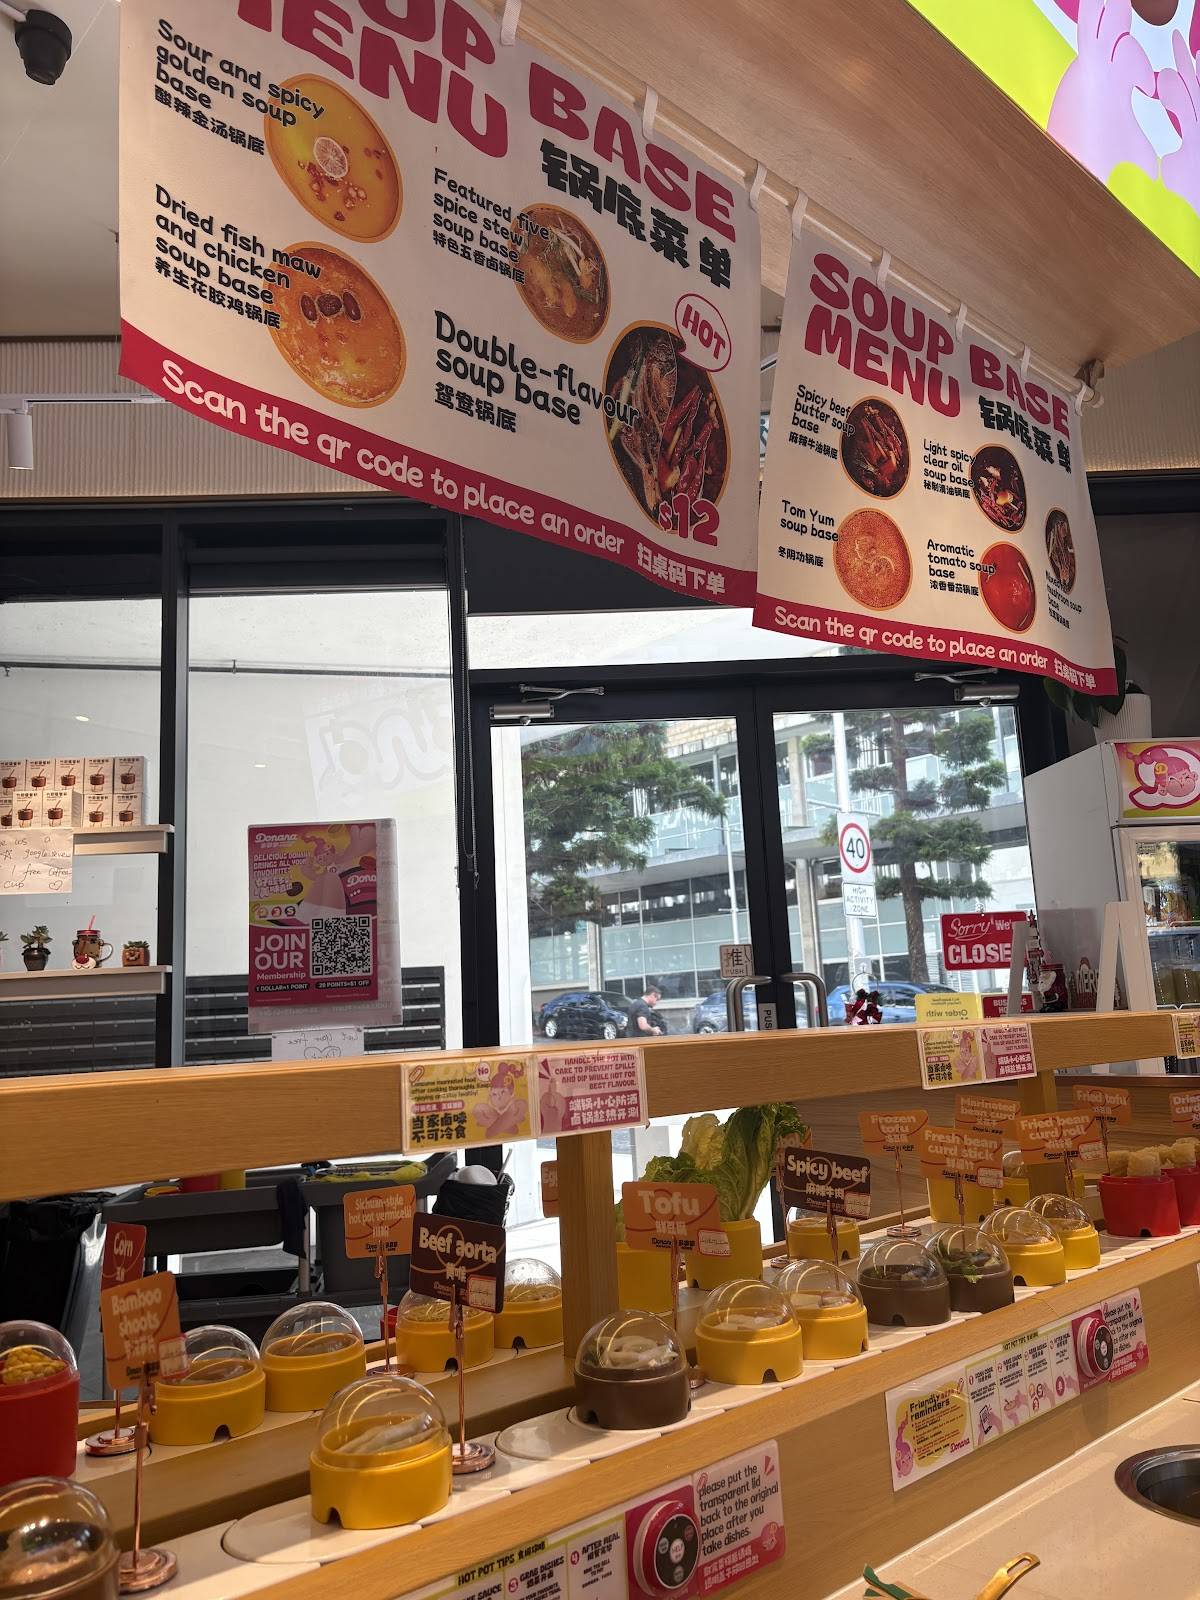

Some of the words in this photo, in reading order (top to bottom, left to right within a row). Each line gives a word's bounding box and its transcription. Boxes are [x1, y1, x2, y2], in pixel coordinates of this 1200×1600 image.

[158, 18, 212, 64] Sour
[219, 58, 261, 90] and
[268, 80, 325, 120] spicy
[156, 62, 212, 109] base
[156, 45, 235, 99] golden
[242, 90, 297, 127] soup
[154, 84, 265, 156] 酸辣金汤锅底
[529, 62, 736, 243] BASE
[434, 168, 512, 223] Featured
[517, 213, 551, 240] five
[540, 138, 731, 289] 锅底菜单
[155, 183, 214, 236] Dried
[221, 215, 265, 258] fish
[272, 246, 321, 279] maw
[434, 193, 478, 224] spice
[483, 215, 524, 247] stew
[155, 213, 196, 249] and
[203, 238, 290, 289] chicken
[433, 213, 474, 242] soup
[479, 230, 519, 263] base
[155, 236, 210, 279] soup
[218, 266, 274, 305] base
[432, 230, 525, 285] 特色五香卤锅底
[155, 256, 281, 329] 养生花胶鸡锅底
[682, 304, 726, 360] HOT
[809, 252, 954, 366] SOUP
[969, 343, 1070, 441] BASE
[434, 310, 640, 428] Double-flavour
[804, 303, 961, 418] MENU
[436, 349, 505, 397] soup
[515, 372, 581, 425] base
[796, 384, 827, 409] Spicy
[830, 398, 851, 417] beef
[435, 381, 516, 433] 鸳鸯锅底
[794, 398, 830, 423] butter
[832, 417, 855, 436] soup
[791, 412, 819, 434] base
[161, 359, 247, 424] Scan
[255, 403, 309, 446] the
[317, 432, 351, 463] qr
[357, 448, 424, 488] code
[431, 467, 459, 500] to
[463, 483, 535, 525] place
[541, 512, 570, 538] an
[574, 524, 625, 555] order
[923, 438, 947, 457] Light
[950, 450, 976, 465] spicy
[923, 453, 948, 469] clear
[951, 462, 963, 473] oil
[923, 467, 947, 482] soup
[949, 472, 974, 488] base
[658, 492, 720, 547] $12
[782, 499, 806, 519] Tom
[809, 508, 835, 527] Yum
[780, 518, 808, 536] soup
[811, 527, 839, 542] base
[778, 546, 824, 567] 冬阴功锅底
[927, 539, 975, 558] Aromatic
[636, 542, 726, 595] 扫桌码下单
[928, 552, 967, 569] tomato
[969, 561, 996, 576] soup
[929, 565, 955, 579] base
[774, 605, 821, 633] Scan
[824, 616, 854, 638] the
[858, 626, 878, 645] qr
[881, 630, 923, 650] code
[927, 634, 946, 653] to
[950, 636, 995, 658] place
[998, 647, 1017, 663] an
[1019, 650, 1048, 670] order
[845, 837, 865, 860] 40
[846, 895, 874, 905] ACTIVITY
[852, 887, 868, 895] HIGH
[852, 905, 870, 913] ZONE
[255, 933, 306, 952] JOIN
[947, 918, 991, 941] Sorry
[255, 951, 304, 970] OUR
[723, 948, 744, 967] 推
[948, 943, 1012, 964] CLOSE
[256, 971, 306, 981] Membership
[763, 1009, 773, 1030] PUS
[555, 1067, 572, 1075] CARE
[585, 1064, 613, 1072] PREVENT
[960, 1097, 1018, 1112] Marinated
[1076, 1091, 1104, 1102] Fried
[870, 1115, 916, 1123] Frozen
[881, 1123, 909, 1134] tofu
[1020, 1117, 1053, 1130] Fried
[1056, 1115, 1090, 1126] bean
[412, 1125, 466, 1143] 不可冷食
[924, 1130, 962, 1145] Fresh
[963, 1134, 998, 1149] bean
[1029, 1128, 1060, 1140] curd
[1063, 1126, 1087, 1137] roll
[928, 1145, 959, 1157] curd
[786, 1155, 829, 1181] Spicy
[831, 1161, 868, 1183] beef
[638, 1189, 700, 1216] Tofu
[348, 1213, 362, 1225] hot
[363, 1211, 376, 1226] pot
[114, 1234, 133, 1257] Corn
[419, 1226, 453, 1255] Beef
[455, 1239, 498, 1264] aorta
[112, 1288, 162, 1315] Bamboo
[120, 1312, 160, 1335] shoots
[909, 1394, 939, 1412] Friendly
[910, 1400, 950, 1421] reminders
[699, 1479, 726, 1500] please
[727, 1470, 742, 1485] put
[744, 1465, 758, 1477] the
[699, 1484, 750, 1512] transparent
[751, 1476, 761, 1490] lid
[700, 1511, 721, 1527] back
[723, 1505, 733, 1516] to
[735, 1499, 749, 1511] the
[750, 1482, 779, 1504] original
[701, 1523, 724, 1544] place
[726, 1514, 747, 1530] after
[750, 1506, 765, 1521] you
[702, 1540, 722, 1556] take
[724, 1527, 751, 1546] dishes.
[458, 1571, 476, 1586] HOT
[477, 1562, 495, 1577] POT
[497, 1552, 515, 1567] TIPS
